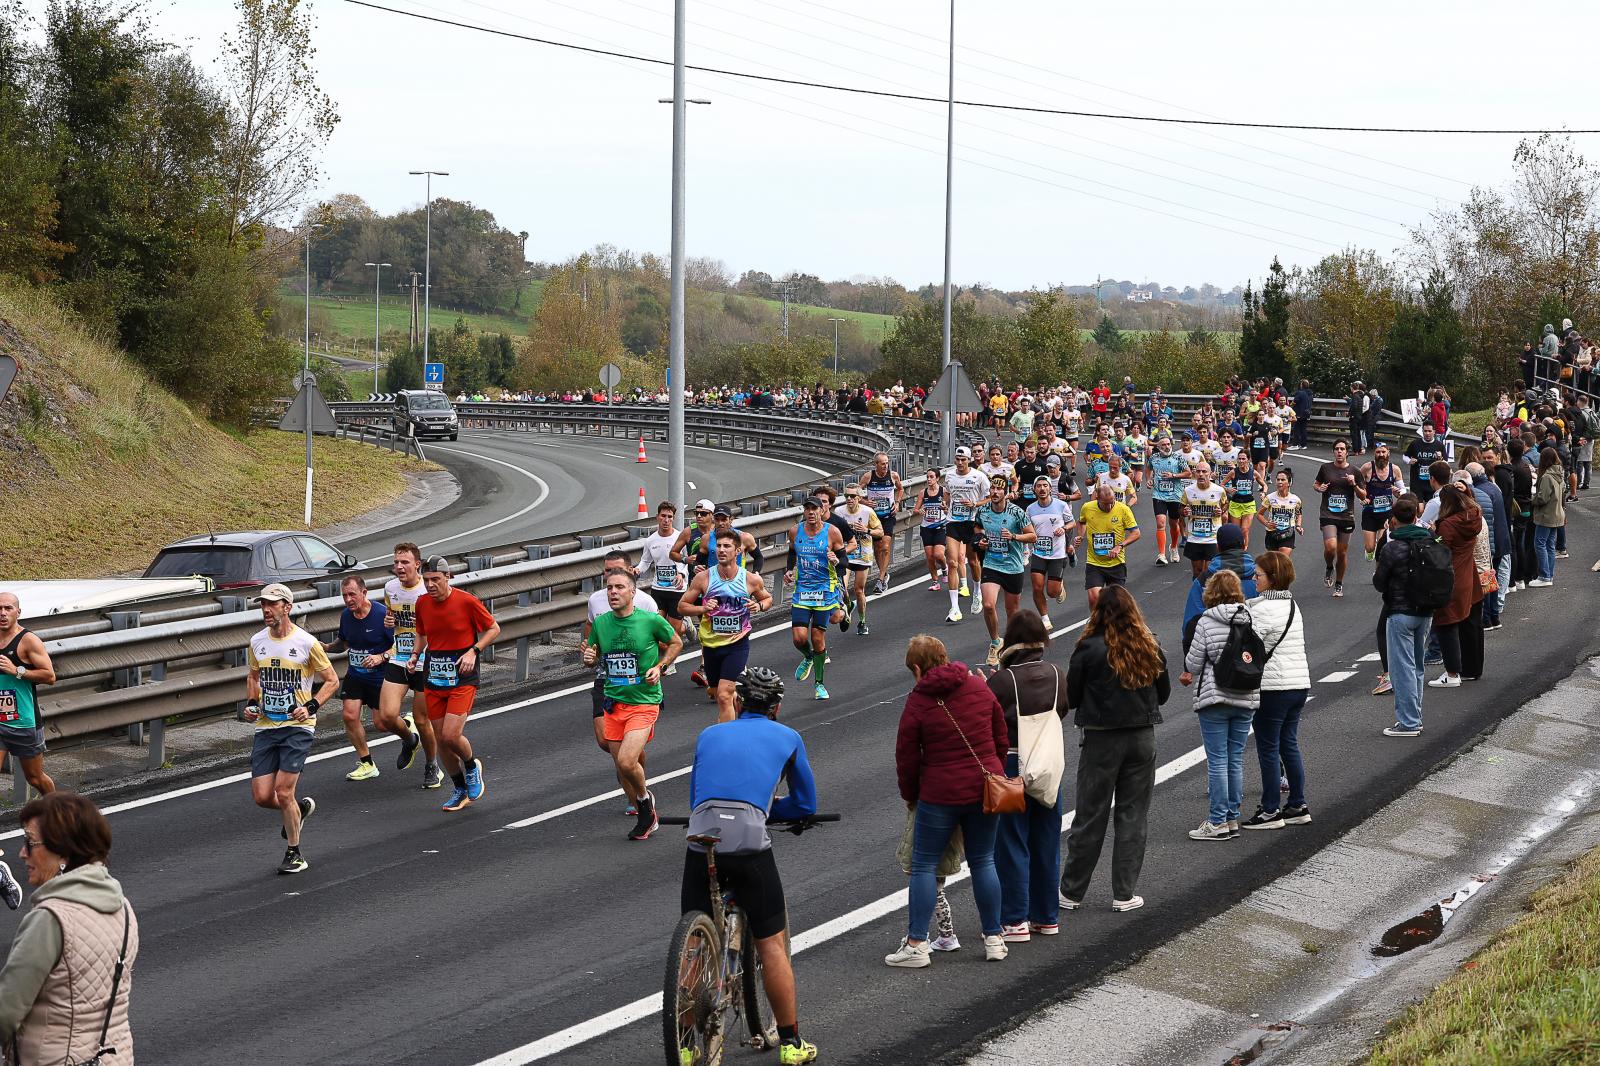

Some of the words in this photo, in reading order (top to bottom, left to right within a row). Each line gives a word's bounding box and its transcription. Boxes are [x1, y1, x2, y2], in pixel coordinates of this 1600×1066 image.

[713, 617, 739, 626] 9605
[271, 658, 281, 667] 59
[607, 659, 635, 669] 7193
[265, 694, 292, 707] 8751
